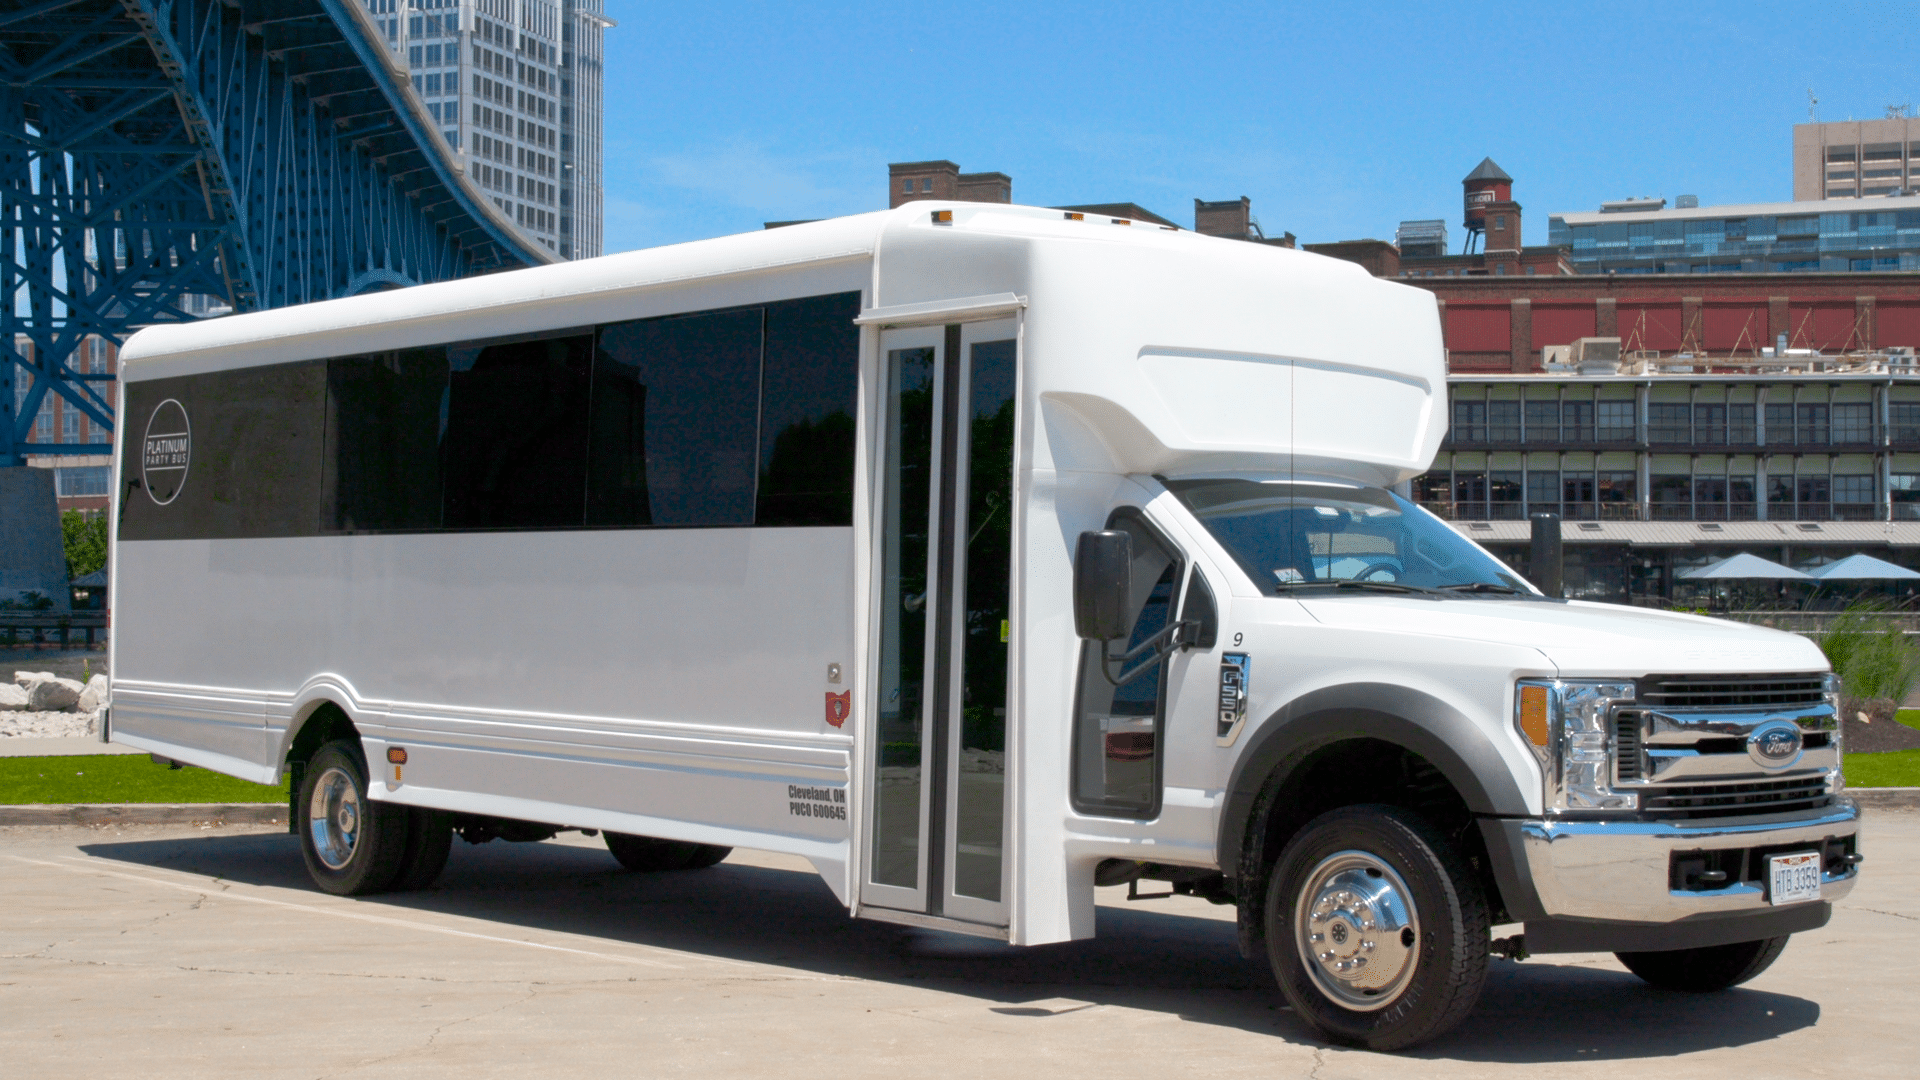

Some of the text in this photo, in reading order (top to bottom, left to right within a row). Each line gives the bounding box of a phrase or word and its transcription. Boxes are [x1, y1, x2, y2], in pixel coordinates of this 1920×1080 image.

[146, 438, 187, 454] PLATINUM
[146, 453, 186, 465] PARTY BUS
[1233, 632, 1244, 647] 9
[1766, 733, 1793, 754] Ford
[788, 784, 846, 803] Cleveland, OH
[789, 801, 847, 821] PUCO 600645
[1775, 866, 1818, 894] HTB 3359
